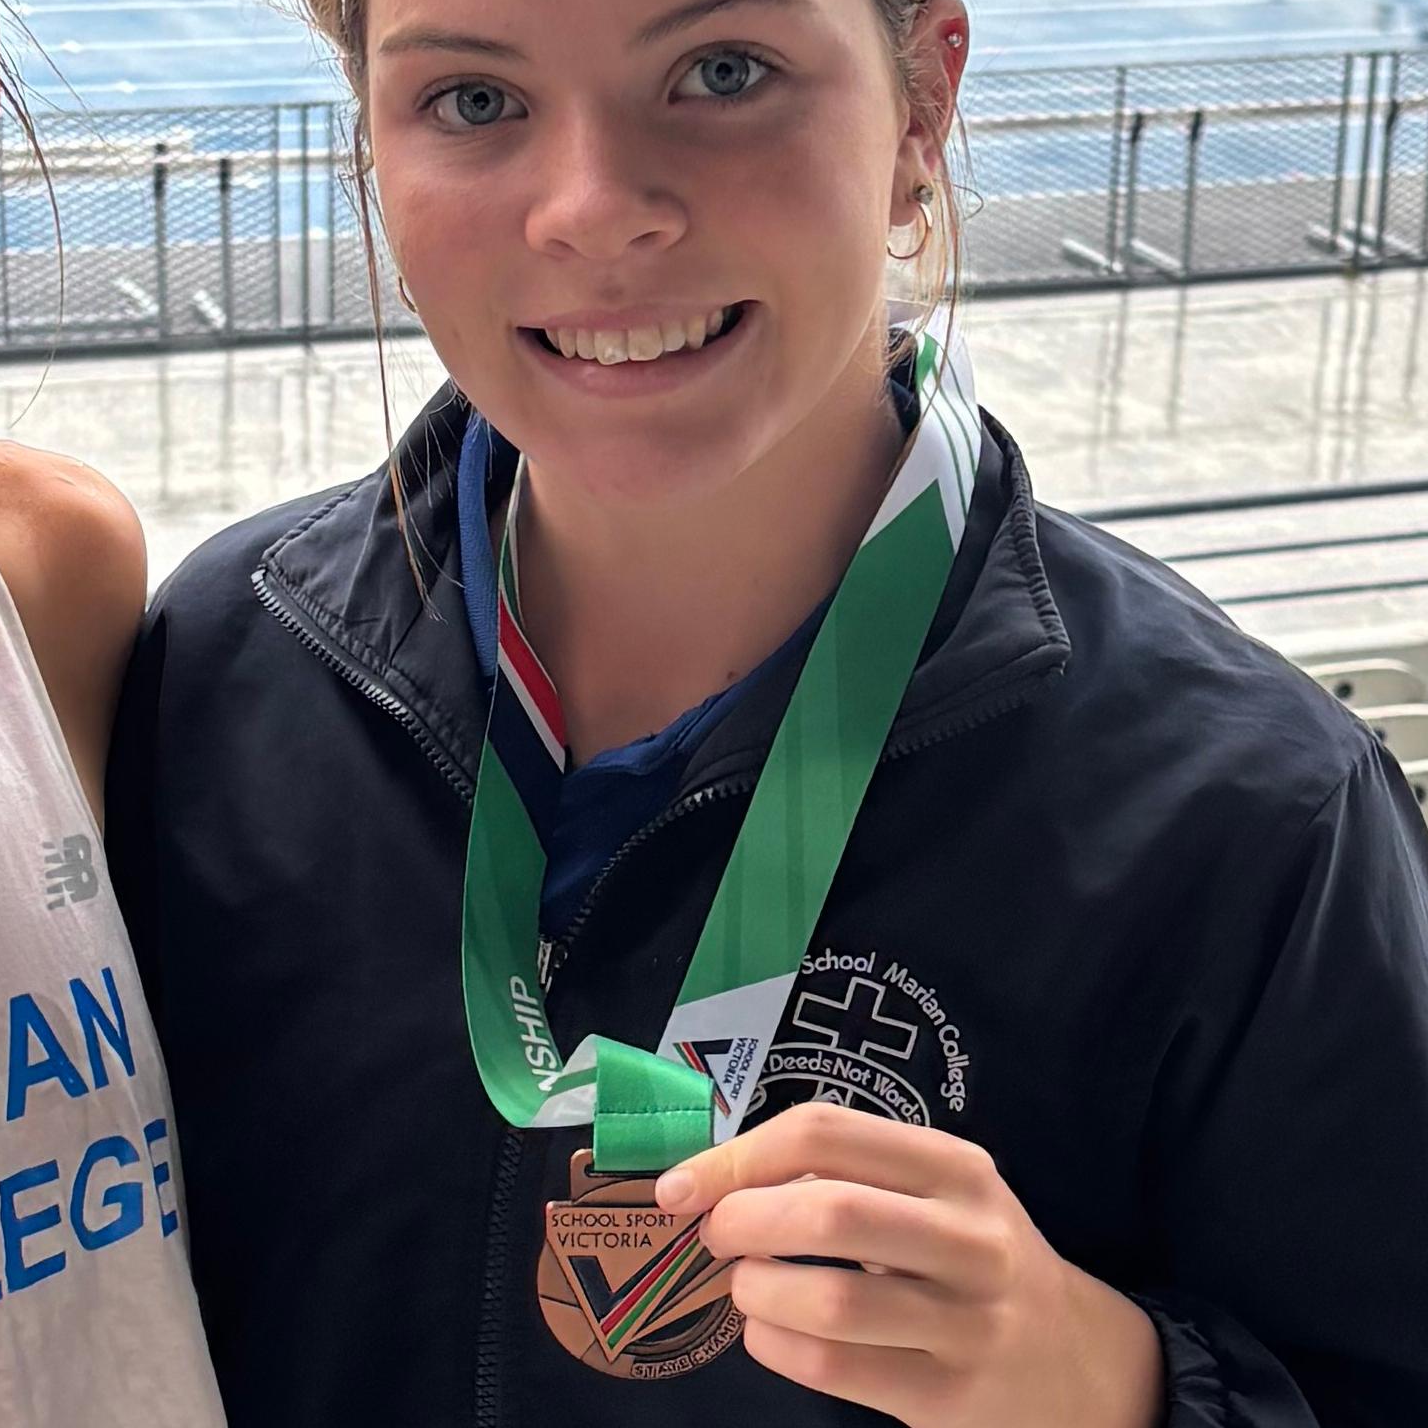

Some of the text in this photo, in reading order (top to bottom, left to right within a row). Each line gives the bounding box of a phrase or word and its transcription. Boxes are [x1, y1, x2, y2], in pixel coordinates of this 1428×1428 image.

[801, 947, 970, 1112] School Marian College
[723, 1036, 749, 1084] VICTORIA
[769, 1051, 833, 1072] Deeds
[832, 1057, 871, 1086] Not
[551, 1213, 677, 1228] SCHOOL SPORT
[557, 1231, 653, 1249] VICTORIA
[634, 1358, 691, 1378] STATE
